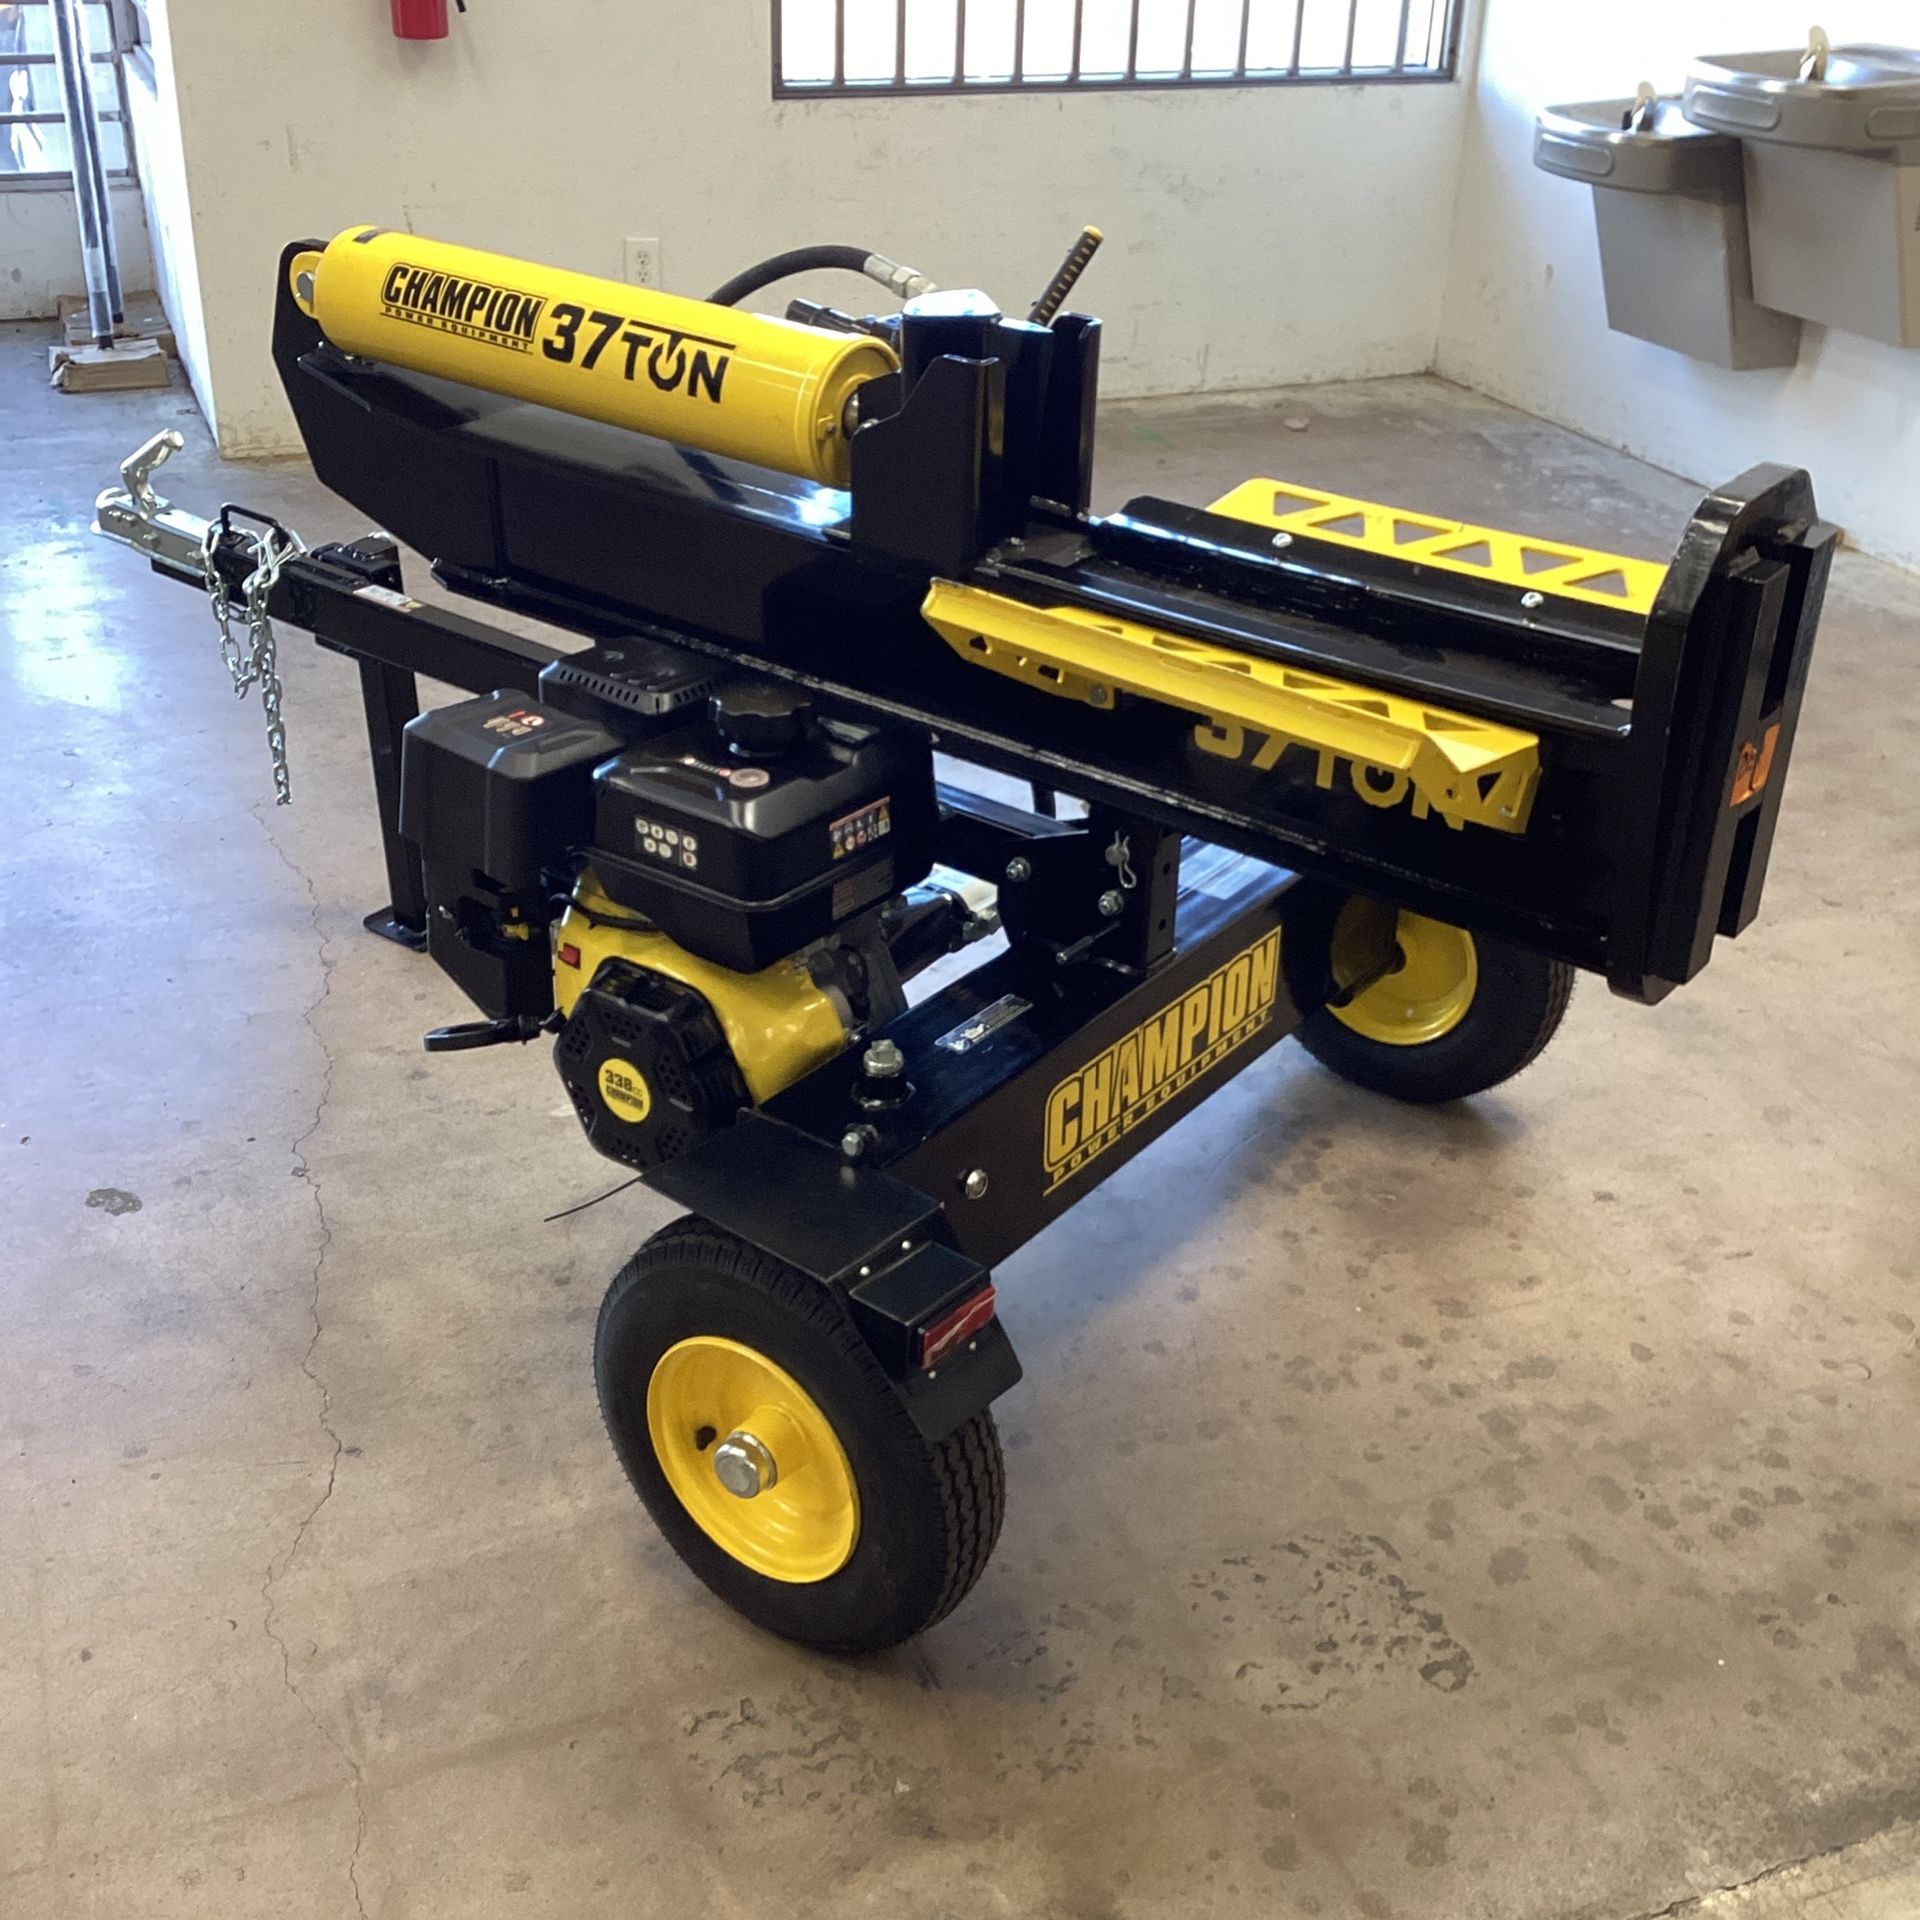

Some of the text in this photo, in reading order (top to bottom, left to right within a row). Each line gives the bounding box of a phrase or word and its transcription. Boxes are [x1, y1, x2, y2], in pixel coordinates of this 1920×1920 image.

[384, 266, 543, 338] CHAMPION
[385, 306, 530, 350] POWER EQUIPMENT
[1051, 933, 1277, 1165] CHAMPION
[1053, 1010, 1269, 1184] POWER EQUIPMENT
